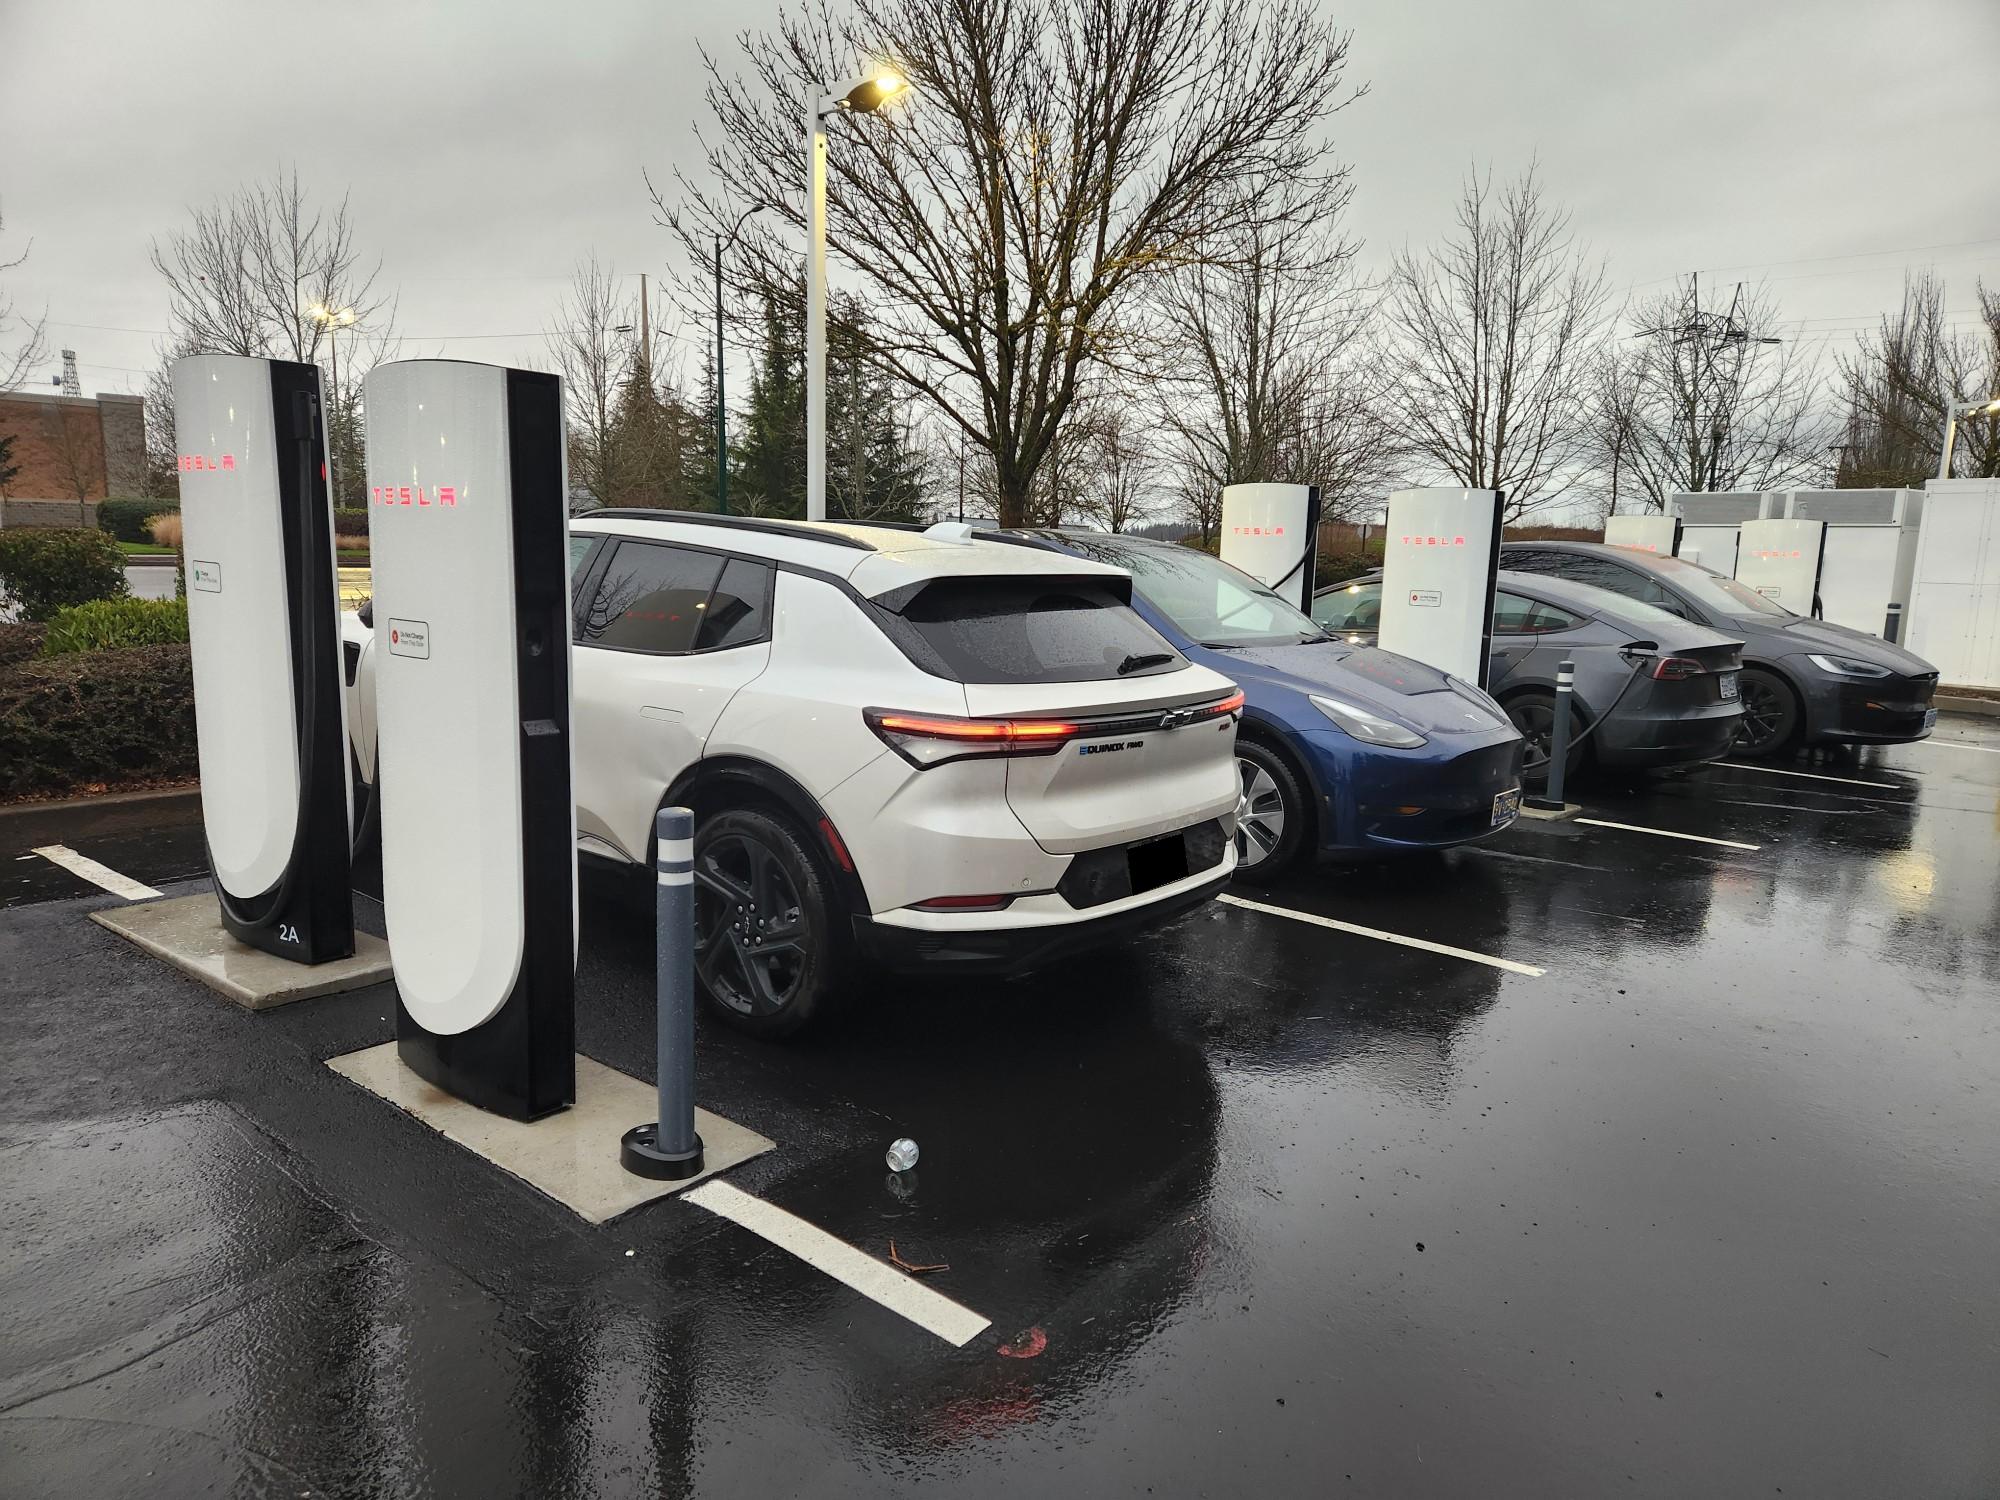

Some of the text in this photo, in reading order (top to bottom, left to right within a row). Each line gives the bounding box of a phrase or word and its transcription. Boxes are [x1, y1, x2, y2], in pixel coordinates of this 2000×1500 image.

[373, 487, 456, 505] TESLA
[1234, 528, 1284, 536] TESLA
[1402, 536, 1465, 546] TESLA
[1080, 742, 1124, 755] EQUINOX
[279, 923, 300, 943] 2A
